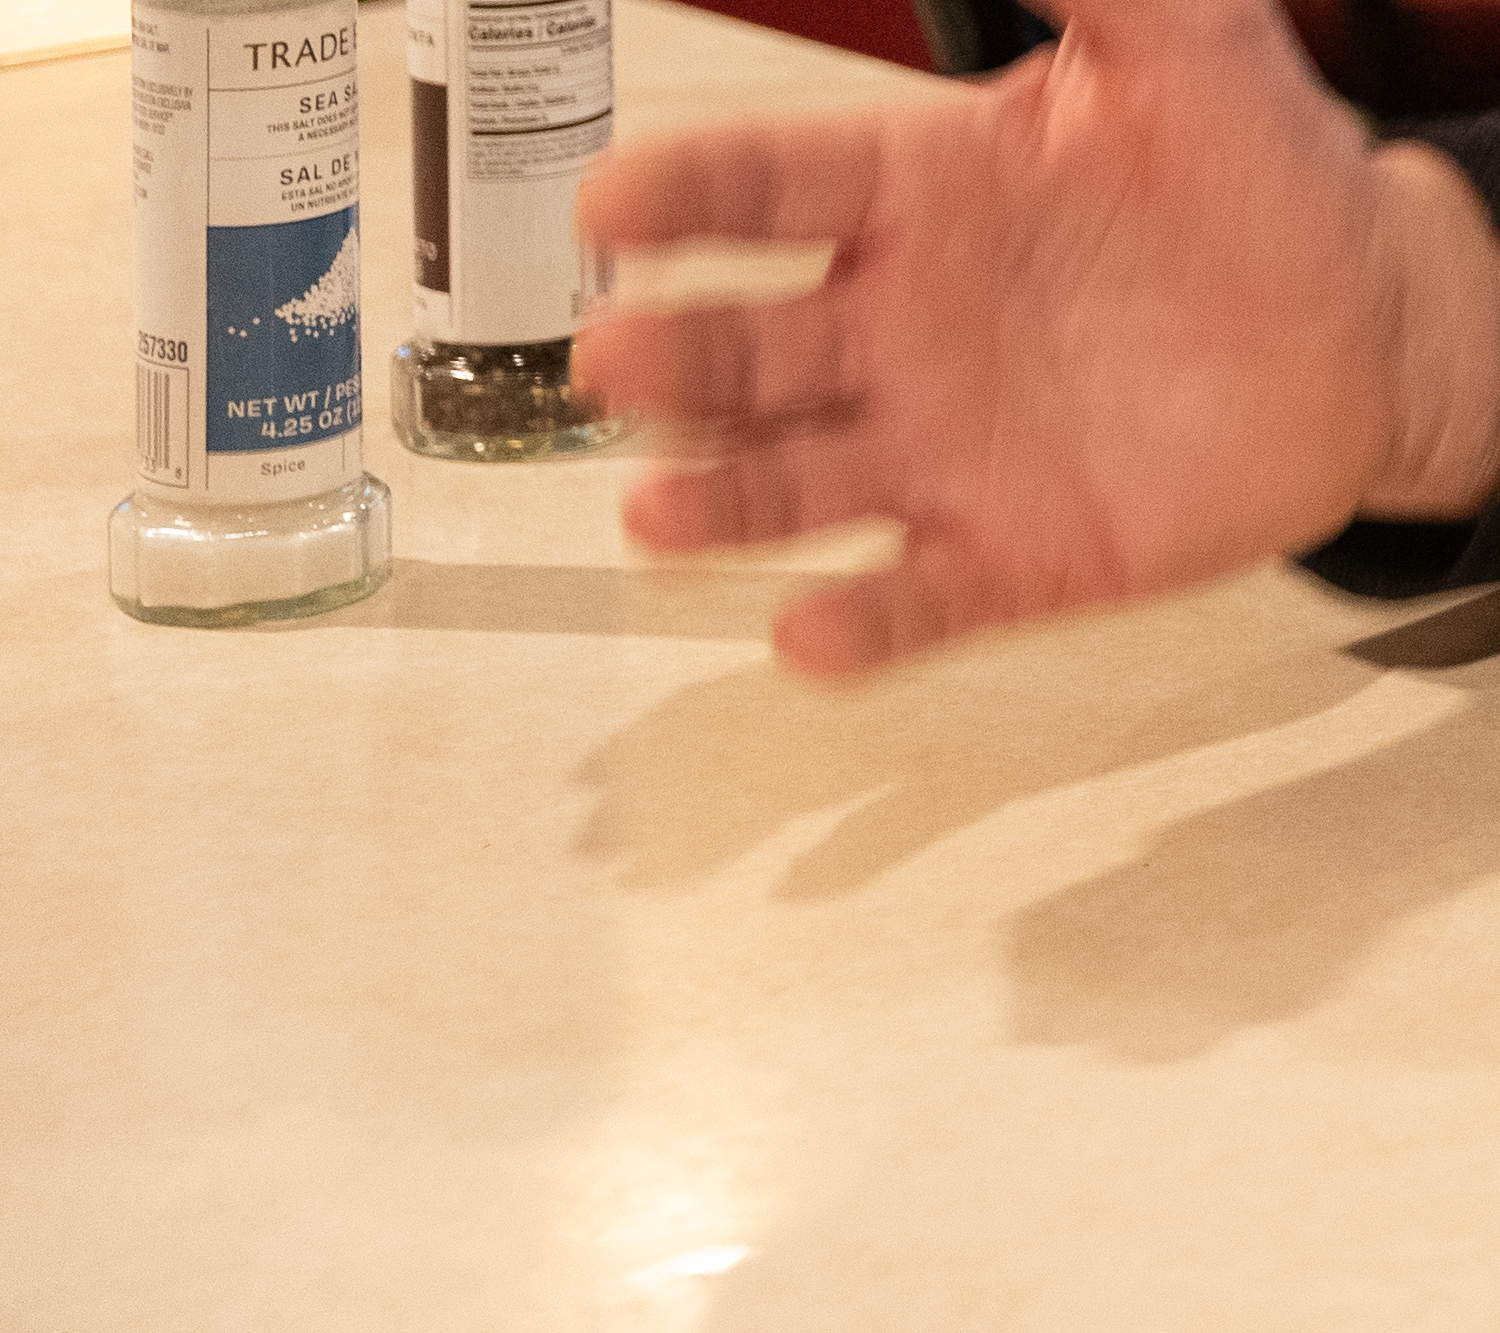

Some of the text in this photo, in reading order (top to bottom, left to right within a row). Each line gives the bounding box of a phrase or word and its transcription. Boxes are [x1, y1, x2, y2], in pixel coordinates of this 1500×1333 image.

[243, 27, 349, 71] TRADE
[300, 91, 339, 114] SEA
[266, 122, 290, 134] THIS
[292, 118, 317, 131] SALT
[298, 133, 305, 142] A
[280, 163, 322, 186] SAL
[331, 156, 350, 176] DE
[281, 190, 306, 201] ESTA
[309, 186, 323, 197] SAL
[291, 202, 305, 213] UN
[227, 397, 278, 418] NET
[284, 390, 320, 413] WT
[261, 415, 313, 439] 4.25
[319, 405, 343, 429] OZ
[260, 459, 306, 477] Spice
